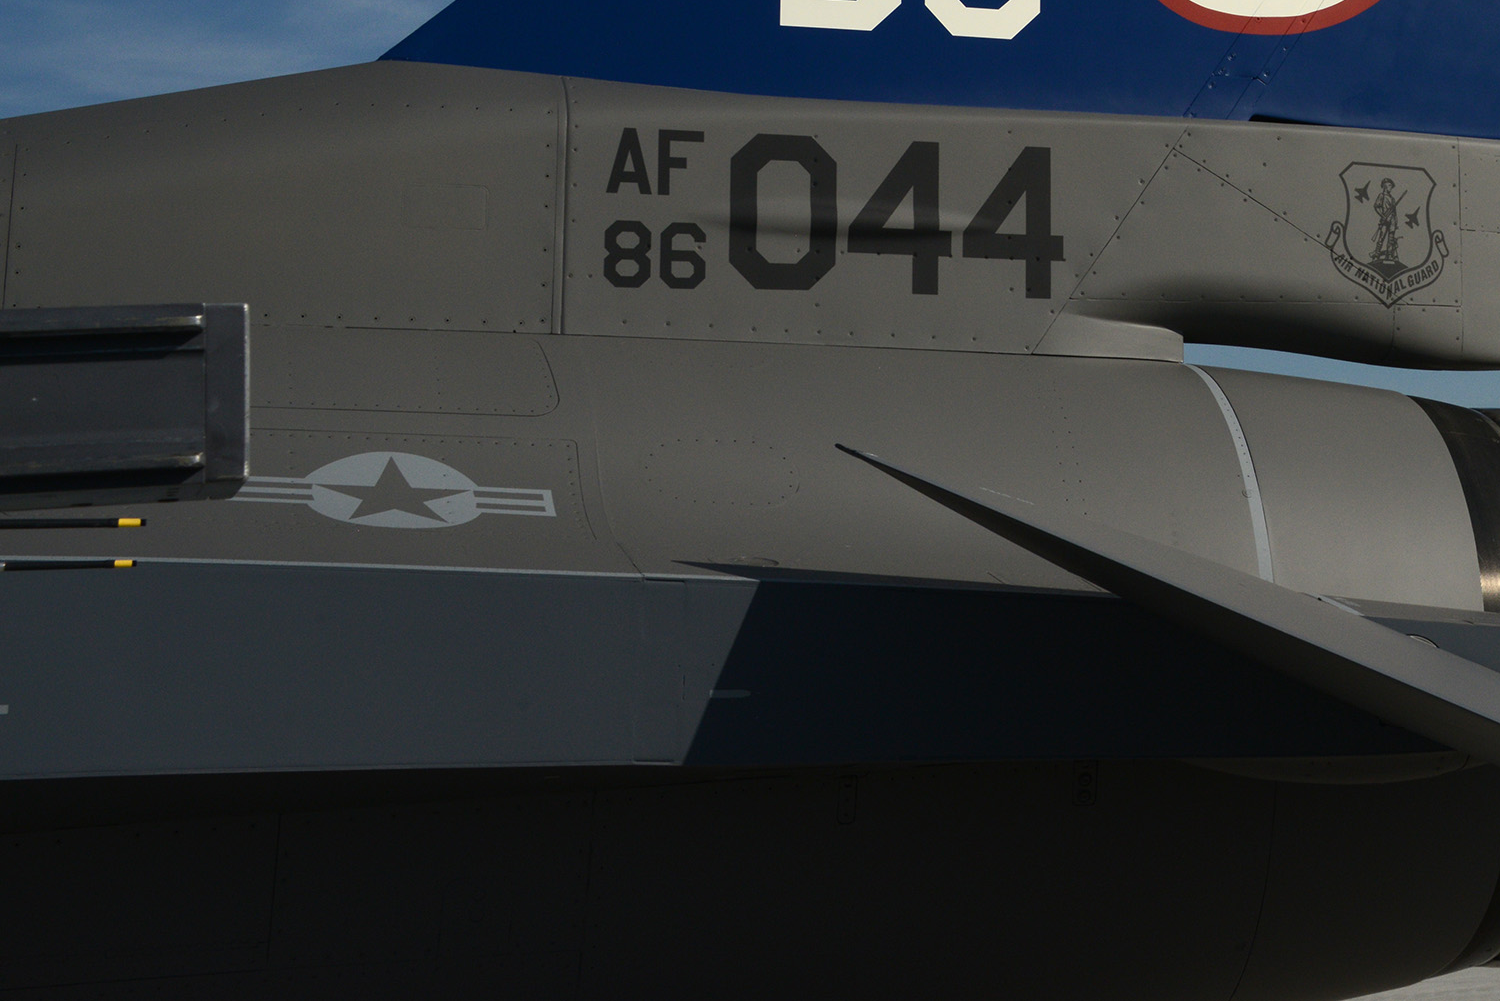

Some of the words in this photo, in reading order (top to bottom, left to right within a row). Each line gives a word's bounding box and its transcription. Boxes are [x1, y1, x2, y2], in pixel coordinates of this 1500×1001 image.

[605, 127, 705, 196] AF
[728, 133, 1065, 299] 044
[603, 220, 706, 290] 86
[1335, 254, 1353, 272] AIR
[1354, 267, 1407, 300] NATIONAL
[1408, 260, 1439, 287] GUARD
